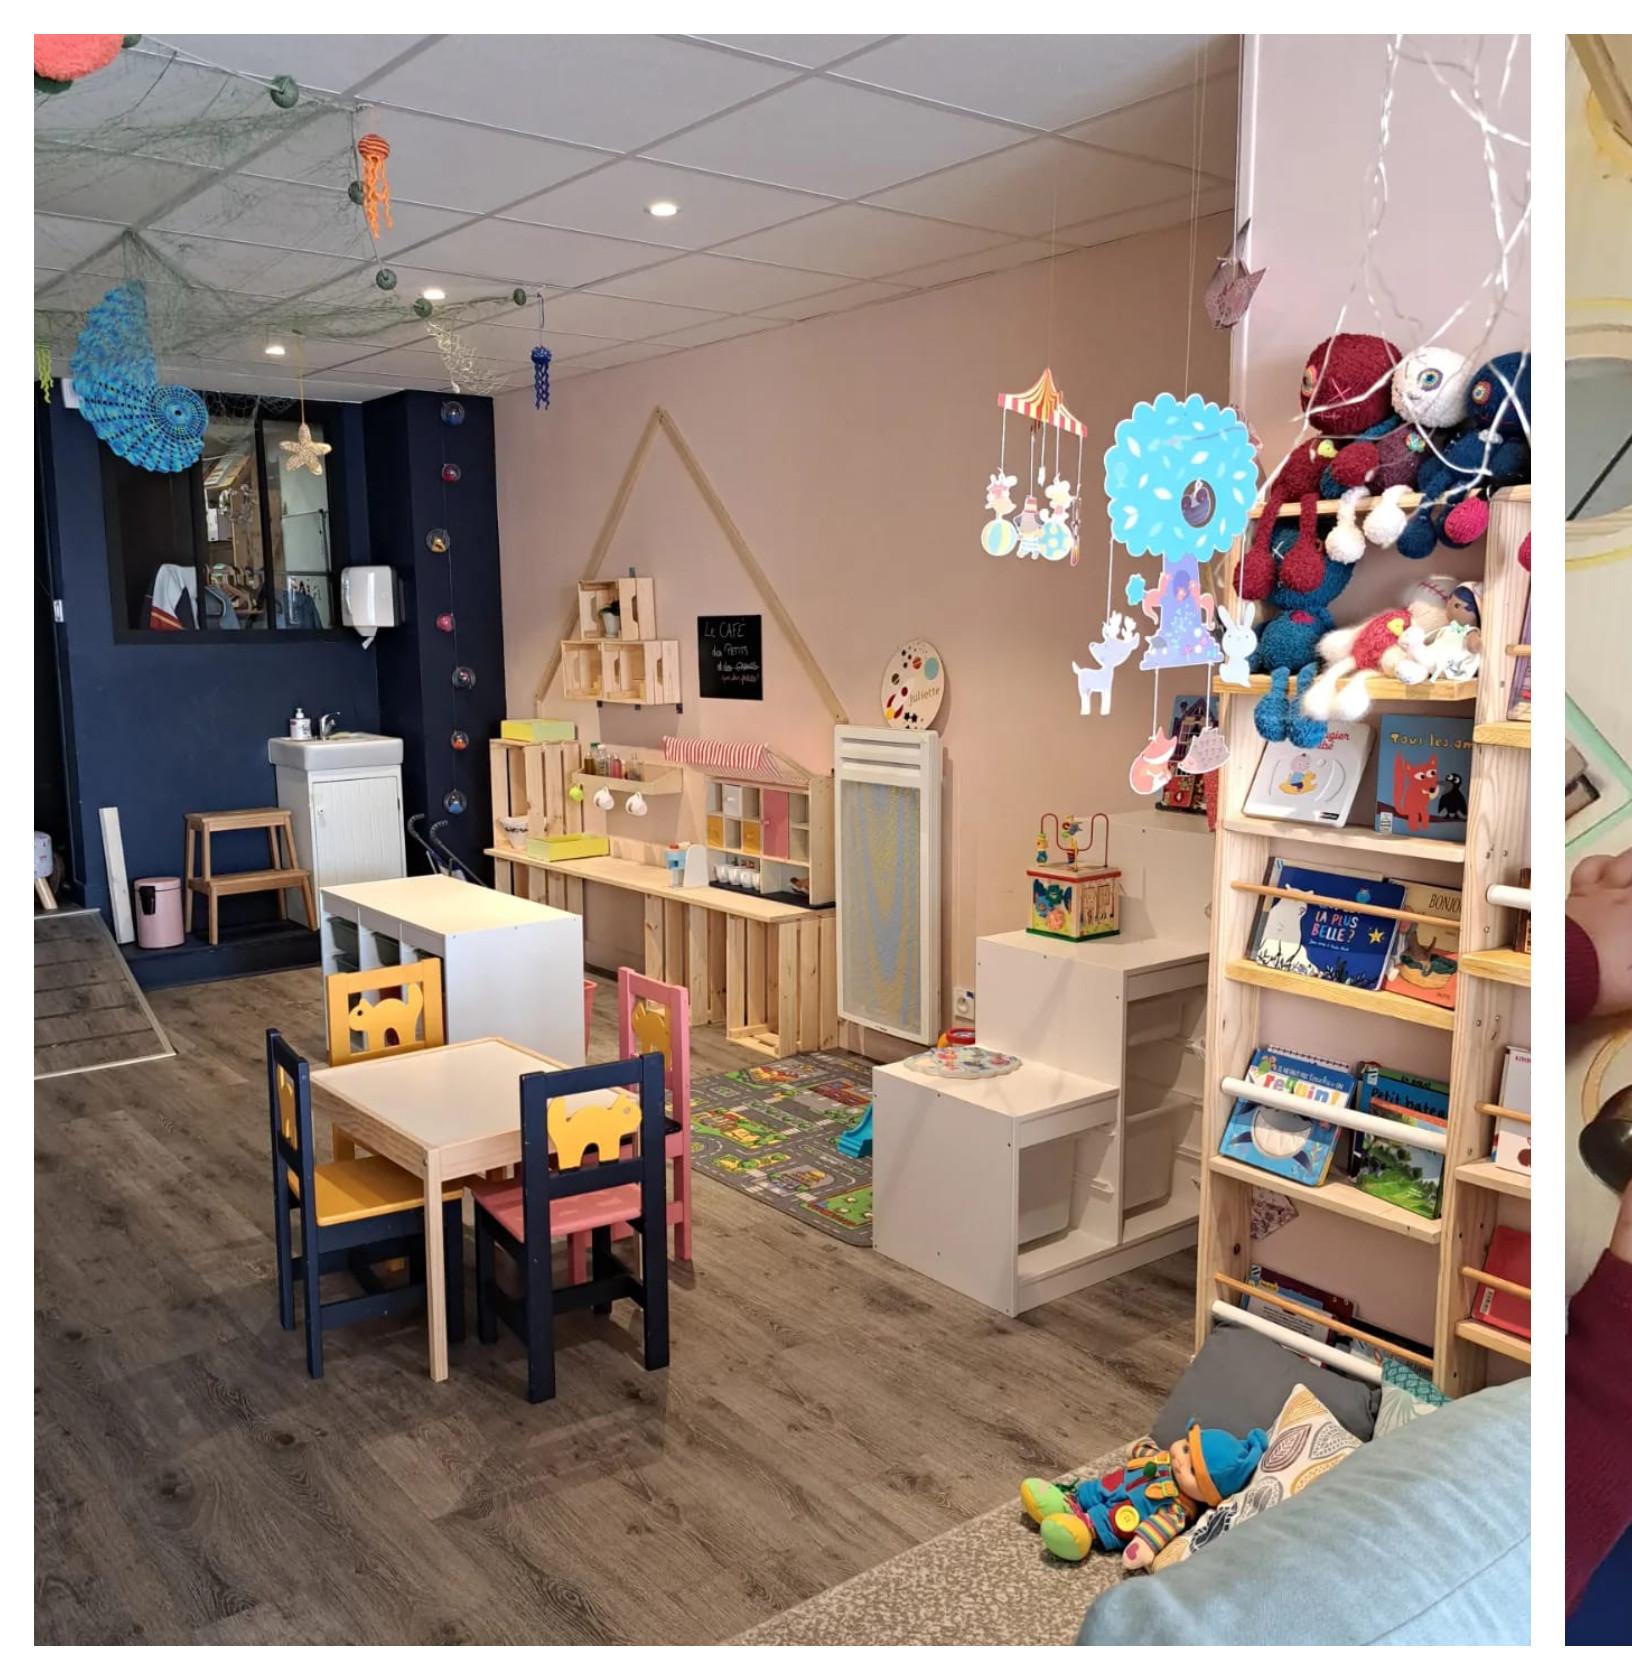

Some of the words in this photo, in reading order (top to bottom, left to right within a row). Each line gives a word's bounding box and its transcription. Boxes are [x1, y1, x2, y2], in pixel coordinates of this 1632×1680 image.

[908, 687, 940, 707] Juliette
[1315, 911, 1328, 924] LA
[1330, 913, 1359, 929] PLUS
[1311, 922, 1346, 943] BELLE
